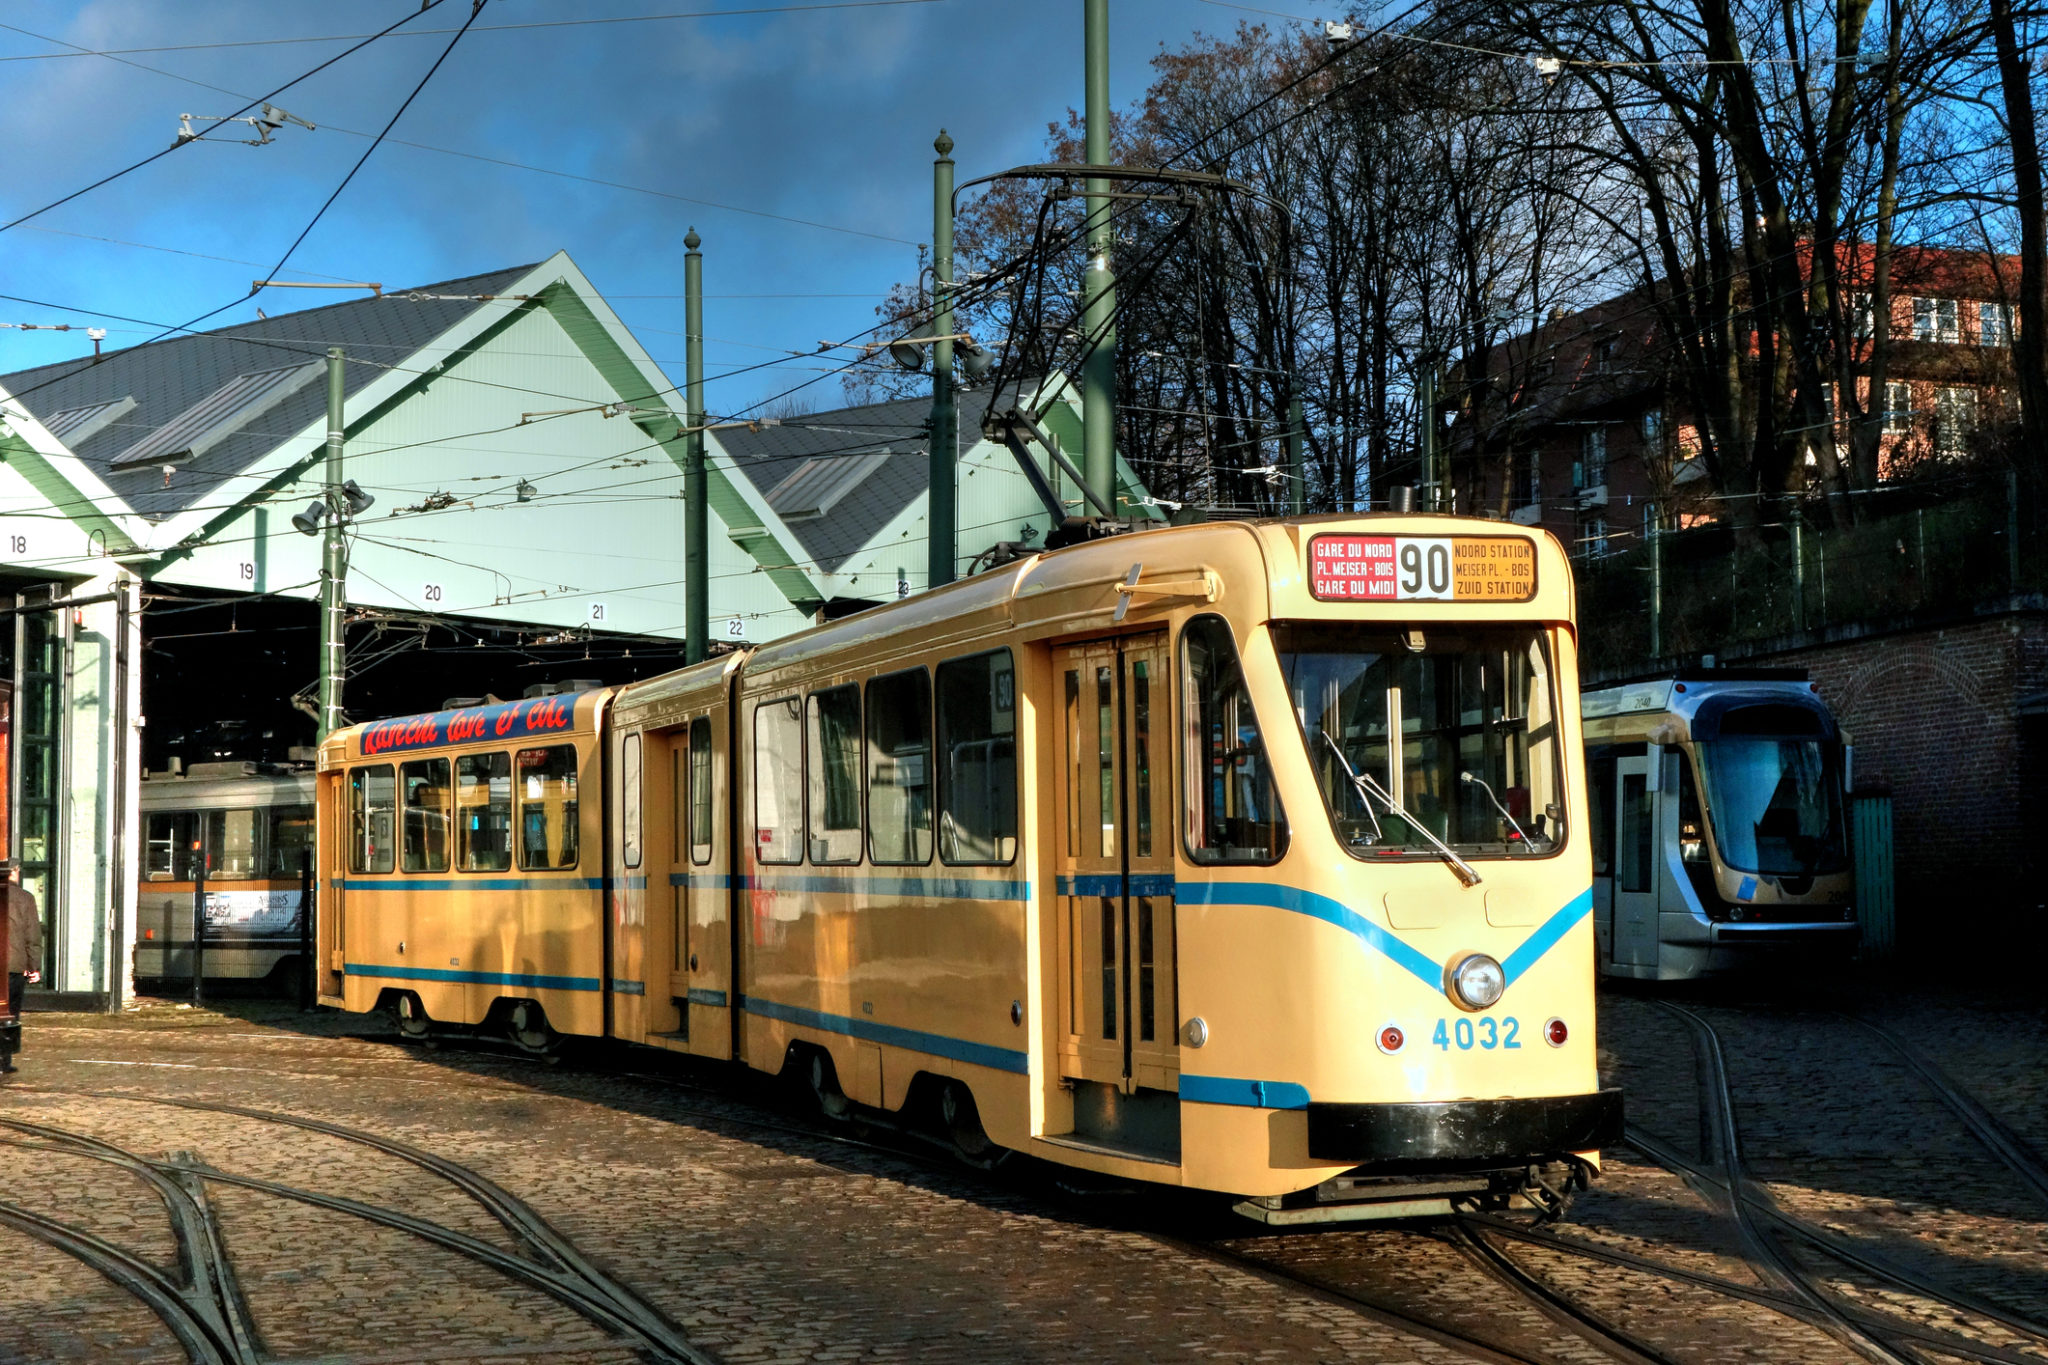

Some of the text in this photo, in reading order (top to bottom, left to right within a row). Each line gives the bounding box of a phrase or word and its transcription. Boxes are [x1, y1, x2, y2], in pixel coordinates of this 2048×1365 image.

[10, 535, 27, 554] 18
[1317, 543, 1393, 558] GARE DU NORD
[1454, 544, 1530, 558] NOORD STATION
[239, 562, 254, 580] 19
[1374, 561, 1394, 576] BOIS
[1400, 543, 1450, 594] 90
[1455, 563, 1487, 576] MEISER
[1511, 563, 1530, 577] BOS
[425, 584, 442, 602] 20
[897, 580, 910, 595] 23
[1317, 580, 1395, 595] GARE DU MIDI
[1457, 581, 1530, 595] ZUID STATION
[592, 604, 604, 620] 21
[729, 620, 743, 636] 22
[1432, 1016, 1522, 1051] 4032
